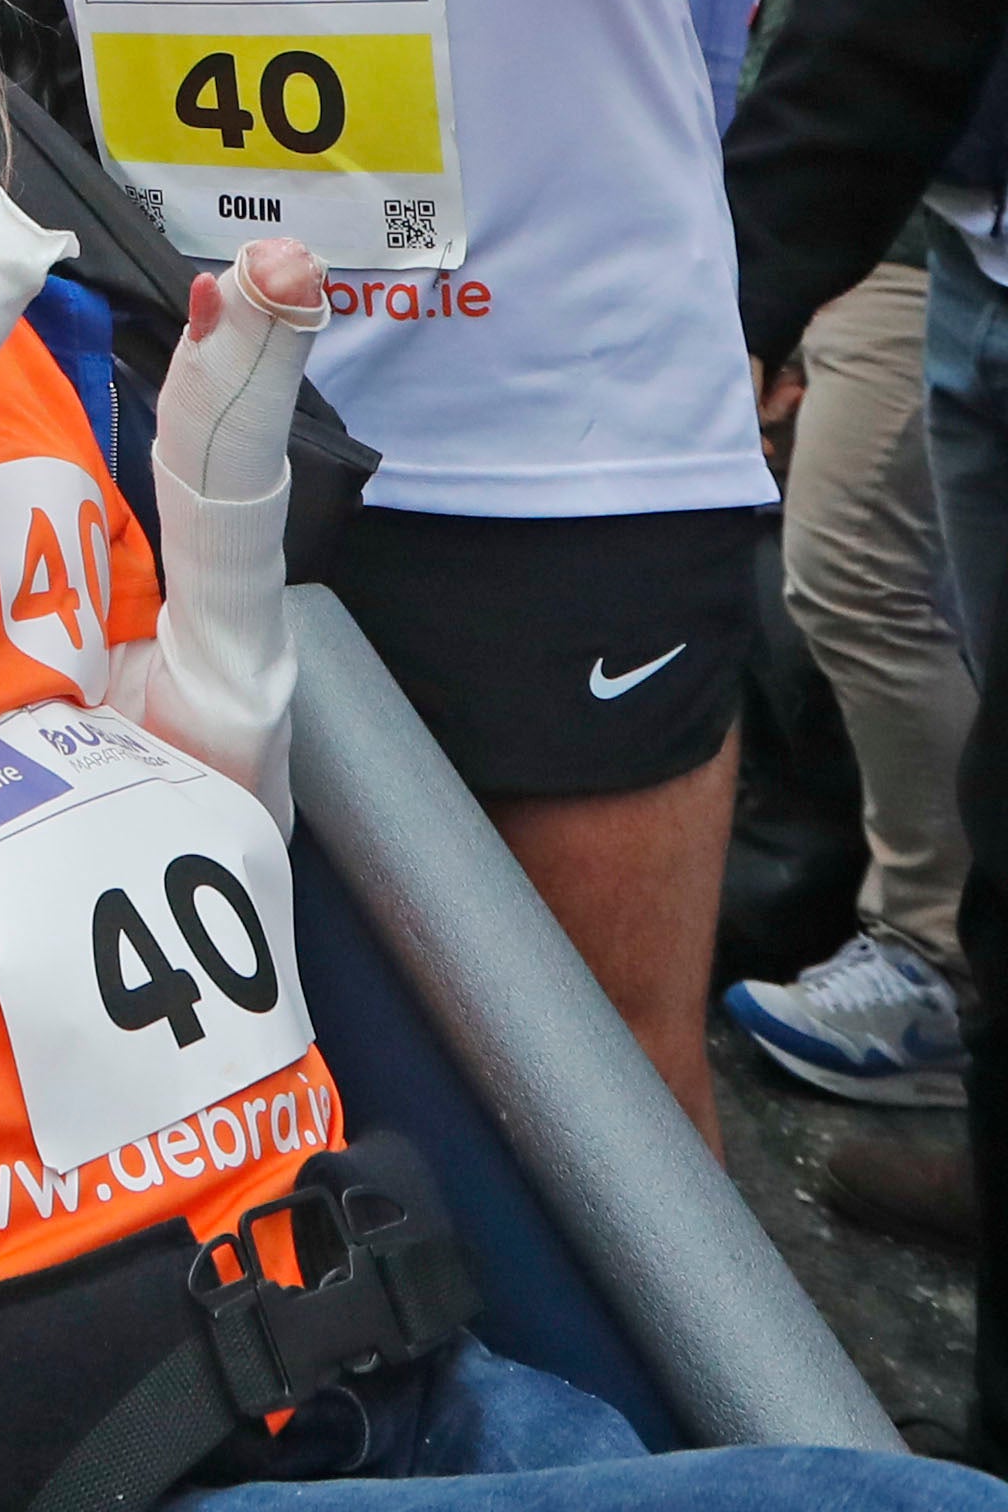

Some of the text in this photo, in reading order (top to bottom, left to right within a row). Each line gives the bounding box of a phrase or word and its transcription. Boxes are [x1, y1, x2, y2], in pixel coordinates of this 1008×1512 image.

[175, 50, 346, 155] 40
[218, 194, 281, 223] COLIN
[92, 854, 280, 1049] 40
